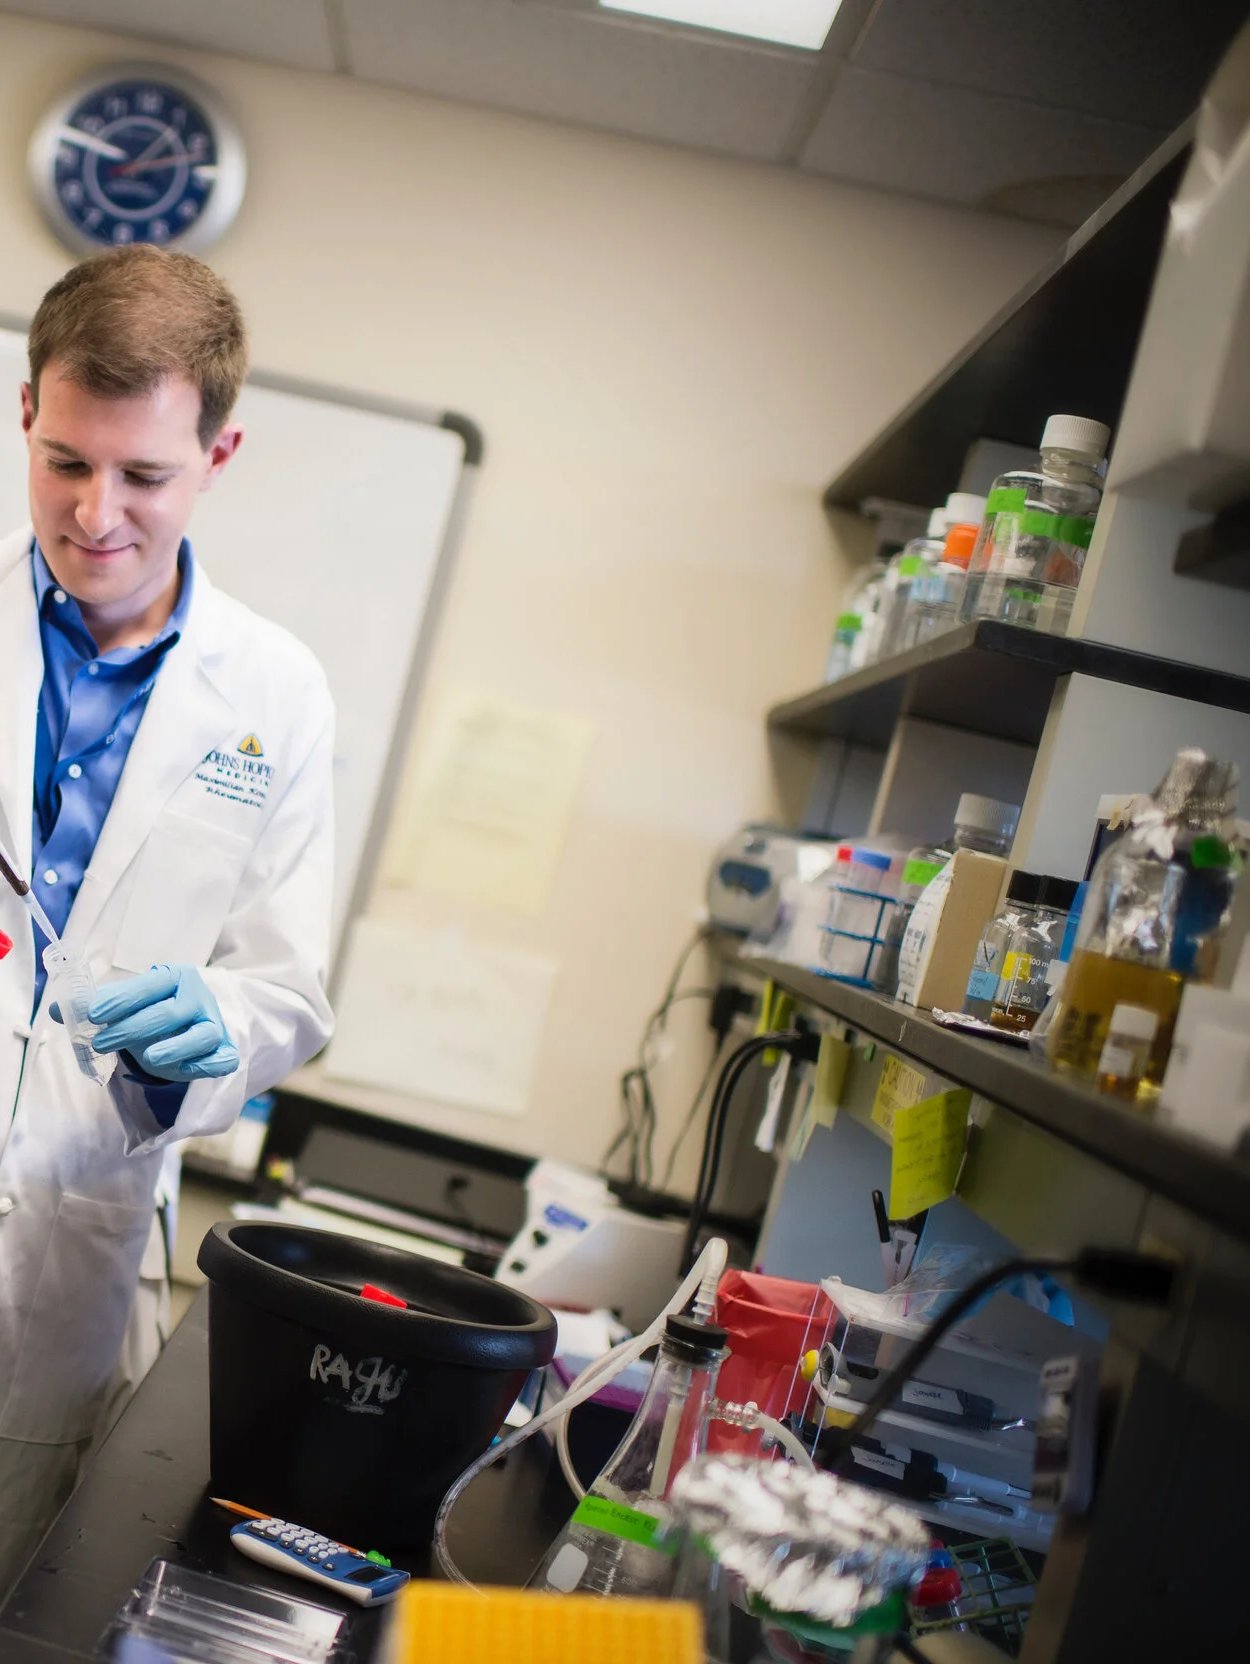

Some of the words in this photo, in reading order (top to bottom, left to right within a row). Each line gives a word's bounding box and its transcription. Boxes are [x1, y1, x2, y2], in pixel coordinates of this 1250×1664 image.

[202, 750, 239, 769] JOHNS
[1027, 977, 1036, 985] 75
[1016, 1014, 1026, 1022] 25
